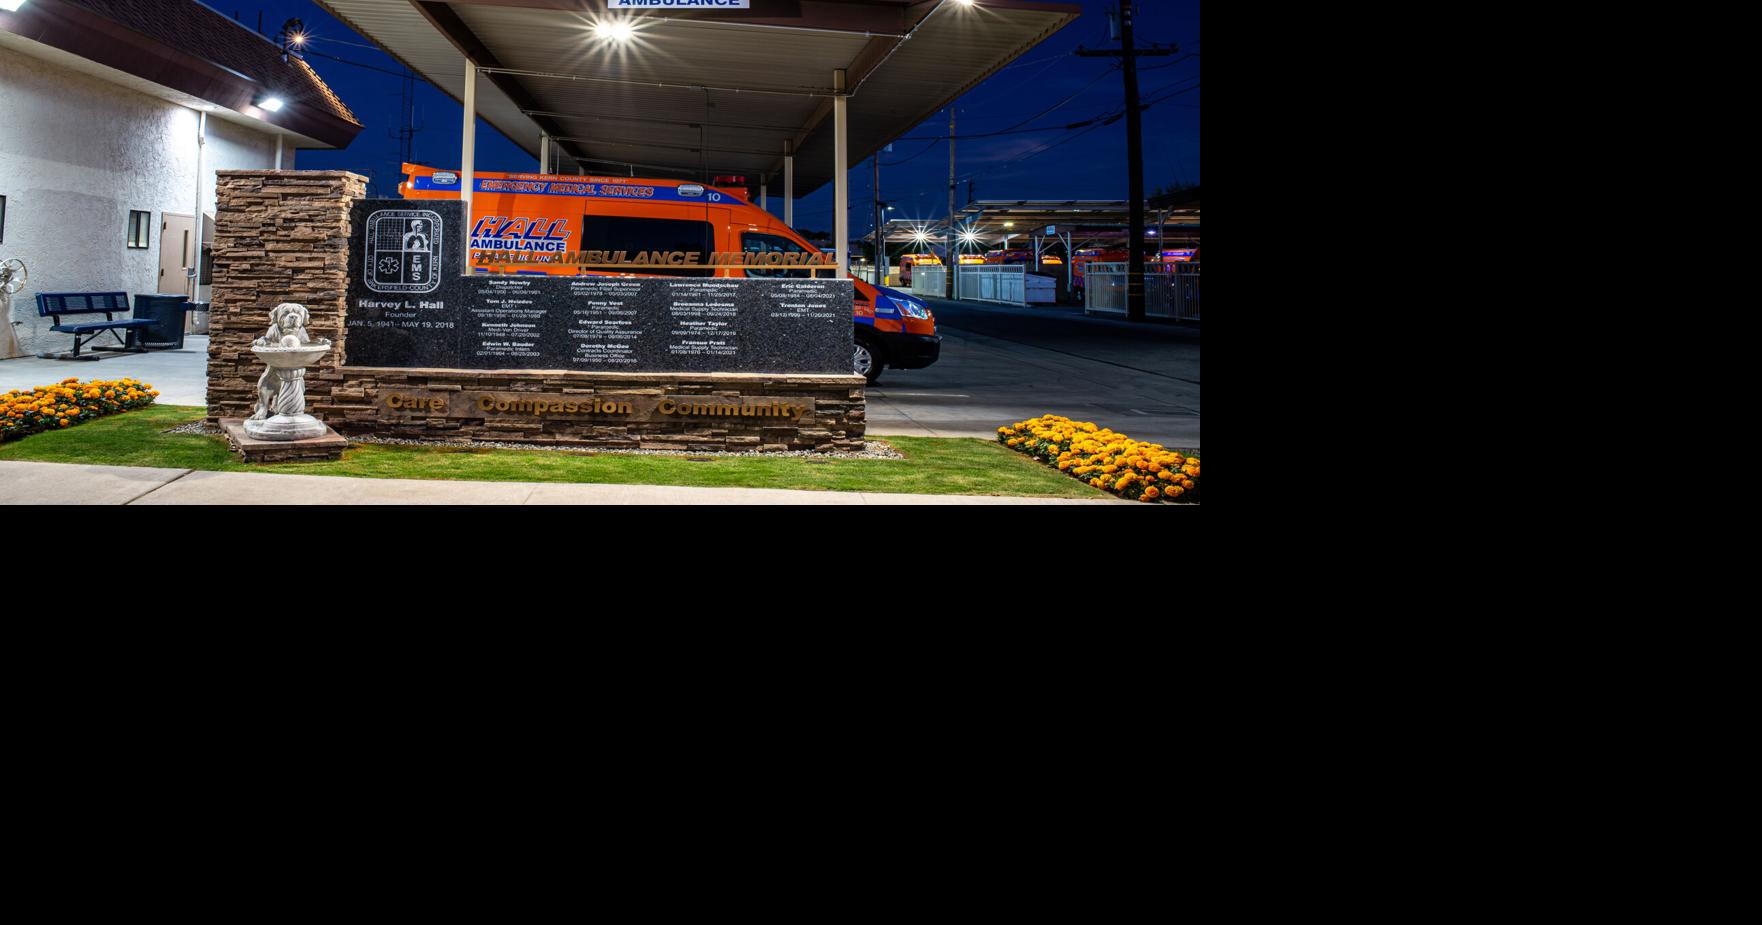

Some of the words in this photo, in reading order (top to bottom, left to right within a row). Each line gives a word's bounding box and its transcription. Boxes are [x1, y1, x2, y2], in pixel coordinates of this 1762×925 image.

[480, 180, 548, 193] EMERGENCY
[548, 182, 597, 196] MEDICAL
[599, 185, 654, 198] SERVICES
[707, 193, 721, 202] 10
[471, 216, 571, 241] HALL
[470, 239, 567, 253] AMBULANCE
[549, 250, 700, 265] AMBULANCE
[708, 252, 839, 267] MEMORIAL
[359, 299, 402, 310] Harvey
[404, 301, 416, 309] L.
[419, 301, 444, 309] Hall
[387, 393, 444, 410] Care
[478, 396, 632, 416] Compassion
[657, 399, 810, 422] Community
